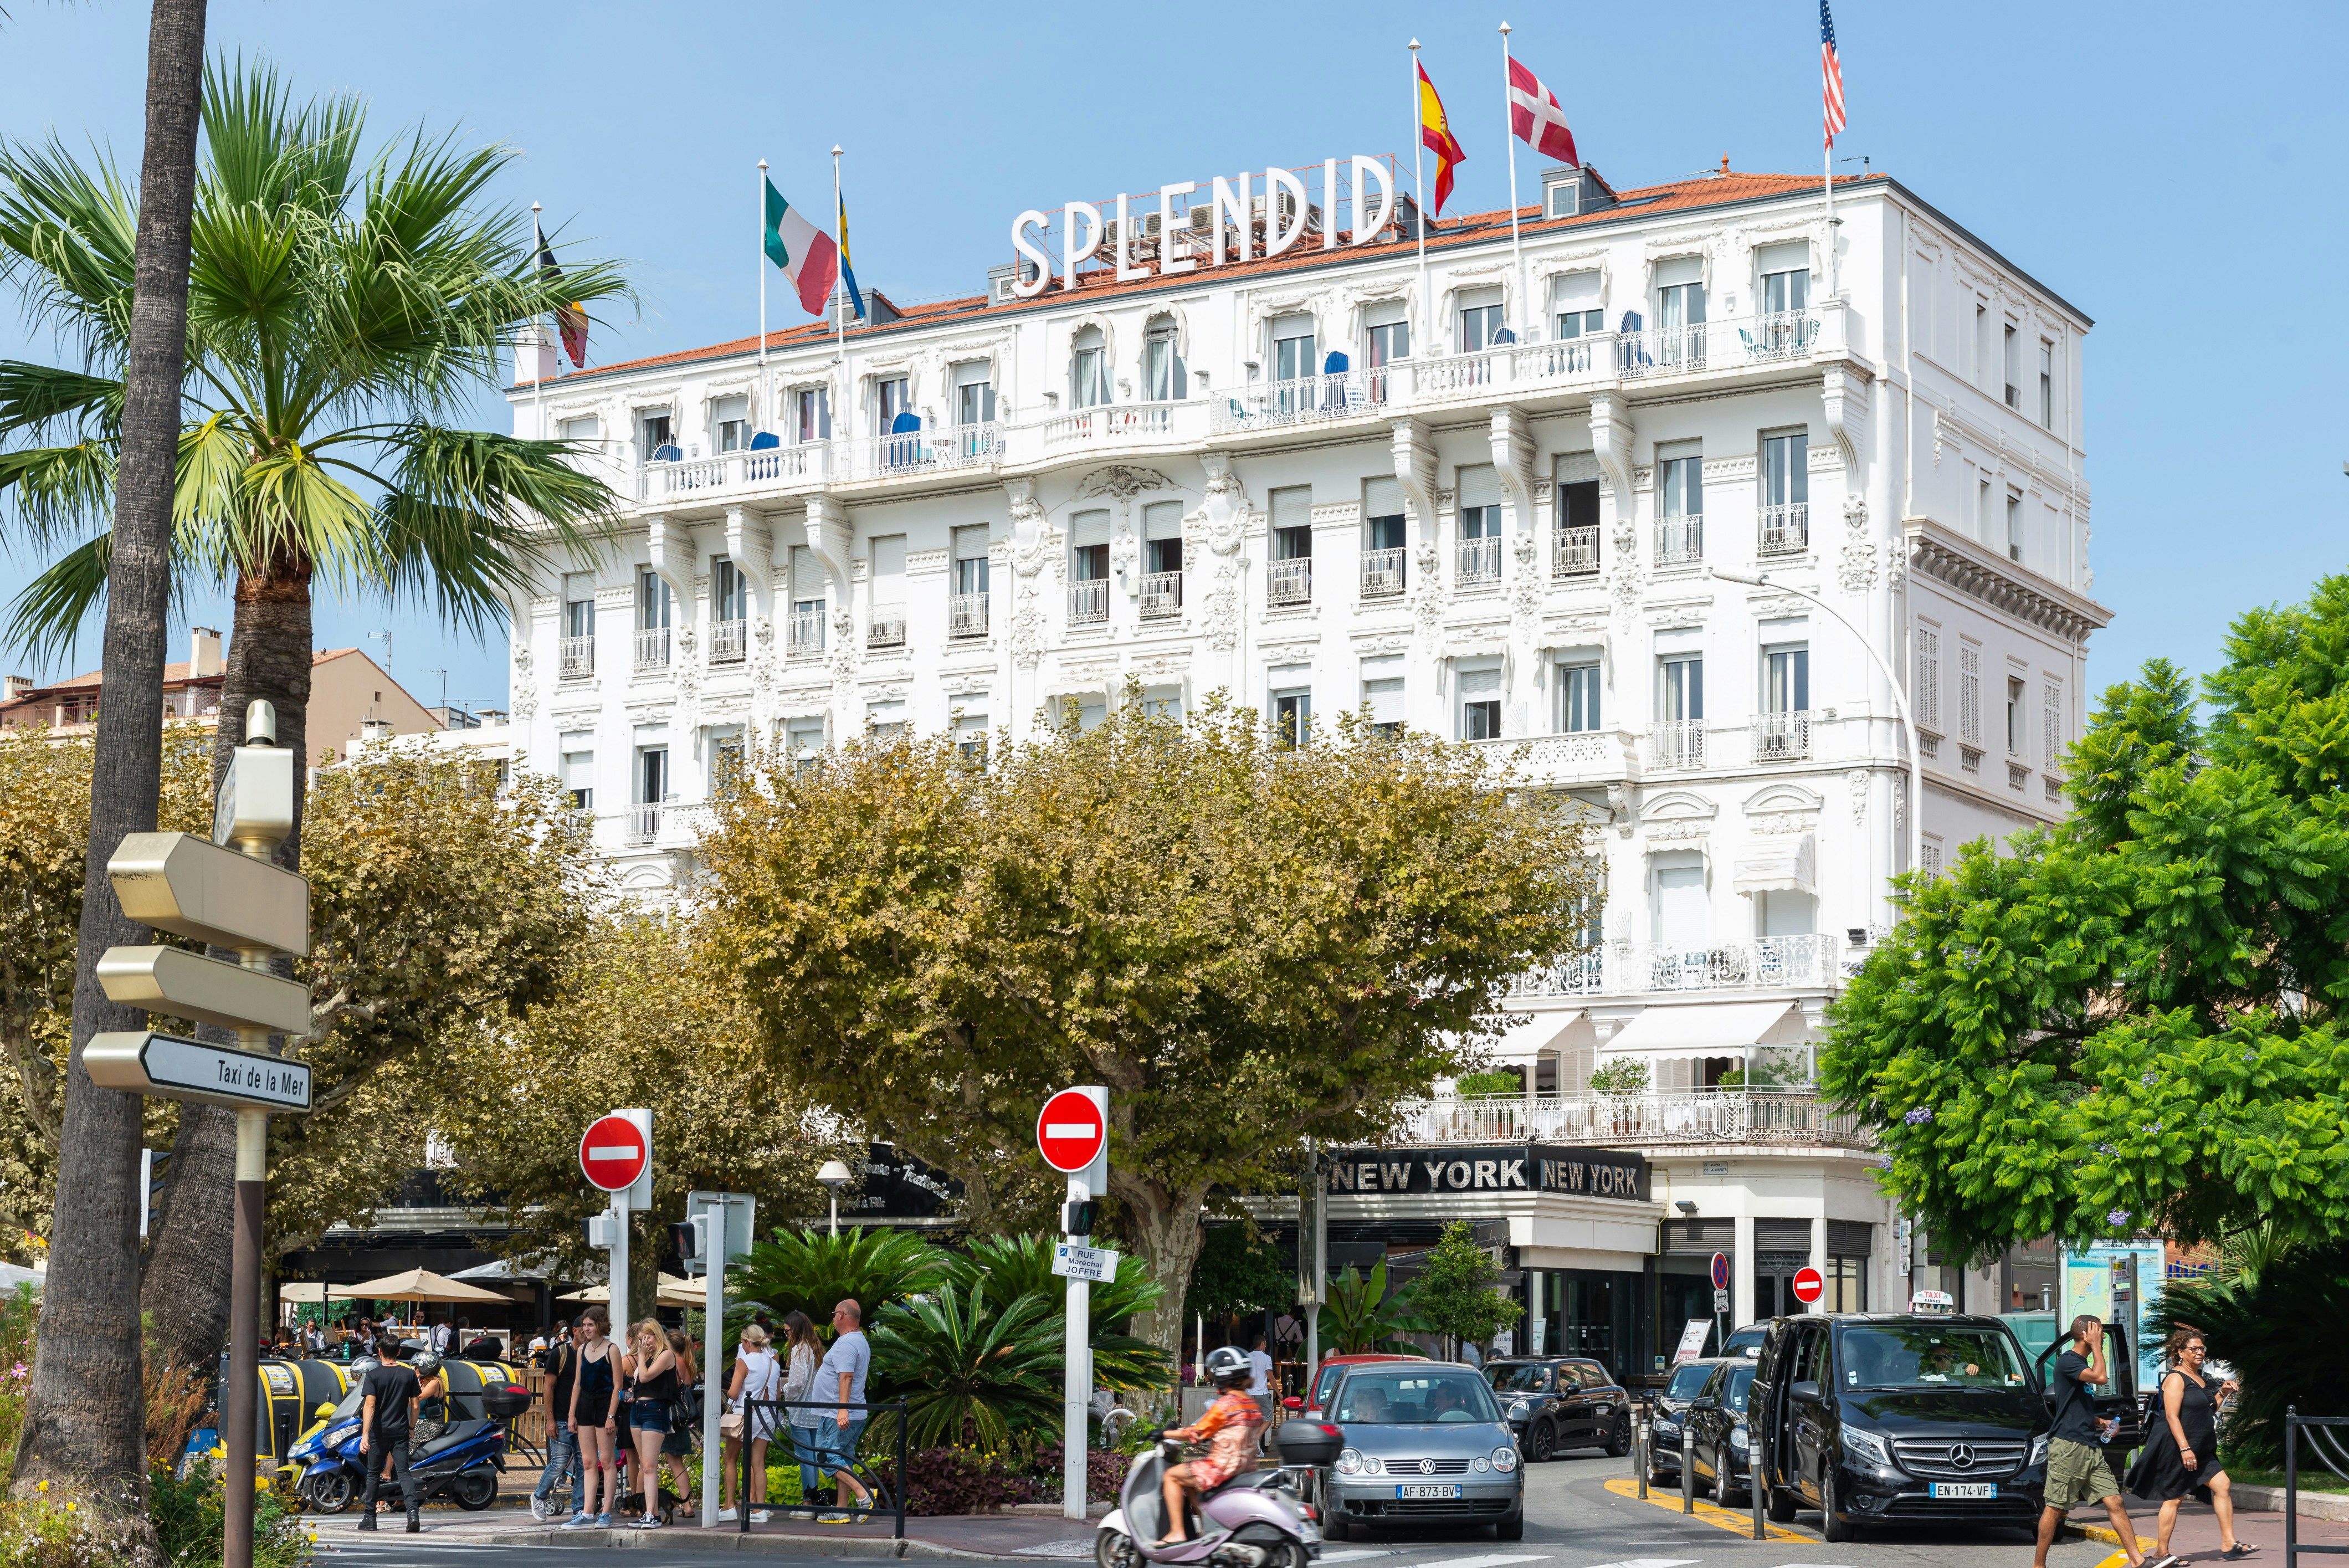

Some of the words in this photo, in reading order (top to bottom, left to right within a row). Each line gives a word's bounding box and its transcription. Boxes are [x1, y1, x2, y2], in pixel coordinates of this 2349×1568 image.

[1010, 155, 1395, 298] SPLENDID
[218, 1059, 242, 1085] Taxi
[247, 1066, 260, 1089] de
[266, 1069, 276, 1092] la
[281, 1072, 304, 1096] Mer
[857, 1157, 890, 1176] House
[1332, 1162, 1411, 1190] NEW
[1423, 1159, 1527, 1188] YORK
[1540, 1159, 1583, 1190] NEW
[1590, 1164, 1639, 1195] YORK
[1077, 1250, 1095, 1259] RUE
[1068, 1257, 1102, 1268] Maréchal
[1065, 1266, 1102, 1278] JOFFRE
[1403, 1487, 1454, 1497] AF-873-BV
[1938, 1485, 1989, 1496] EN-174-VF
